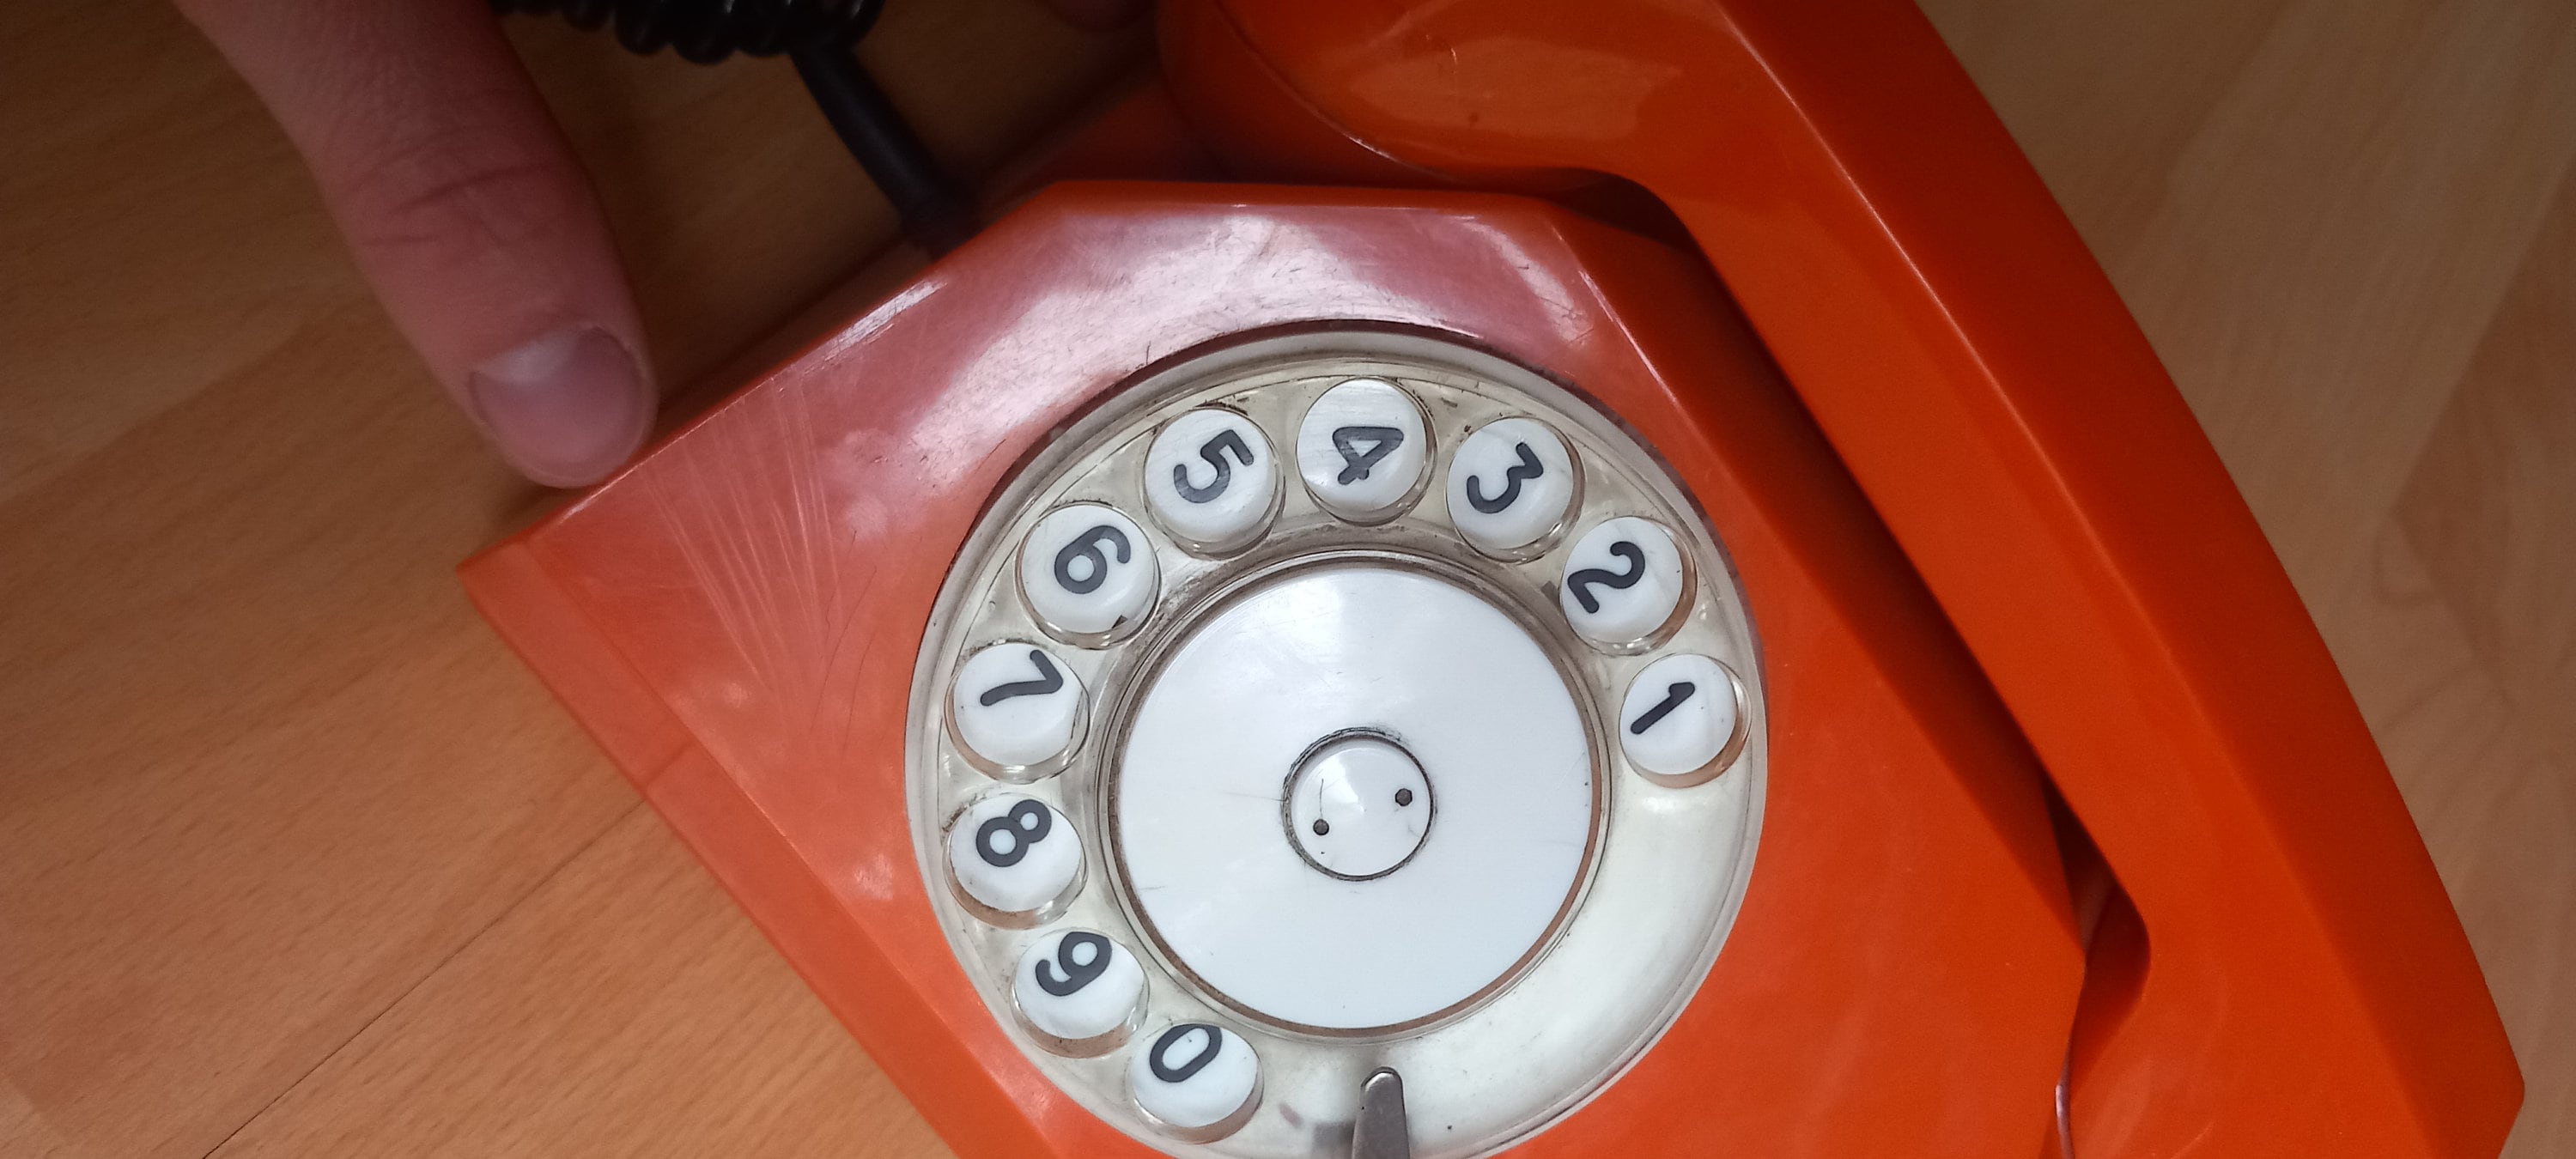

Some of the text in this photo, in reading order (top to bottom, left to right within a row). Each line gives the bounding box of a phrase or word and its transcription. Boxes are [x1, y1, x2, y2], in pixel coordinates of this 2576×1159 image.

[1173, 428, 1255, 504] 5
[1331, 425, 1404, 487] 4
[1466, 441, 1545, 515] 3
[1054, 525, 1131, 595] 6
[1567, 540, 1646, 615] 2
[981, 649, 1064, 707] 7
[1630, 681, 1696, 736] 1
[975, 798, 1052, 868] 8
[1035, 931, 1113, 998] 9
[1149, 1022, 1223, 1083] 0
